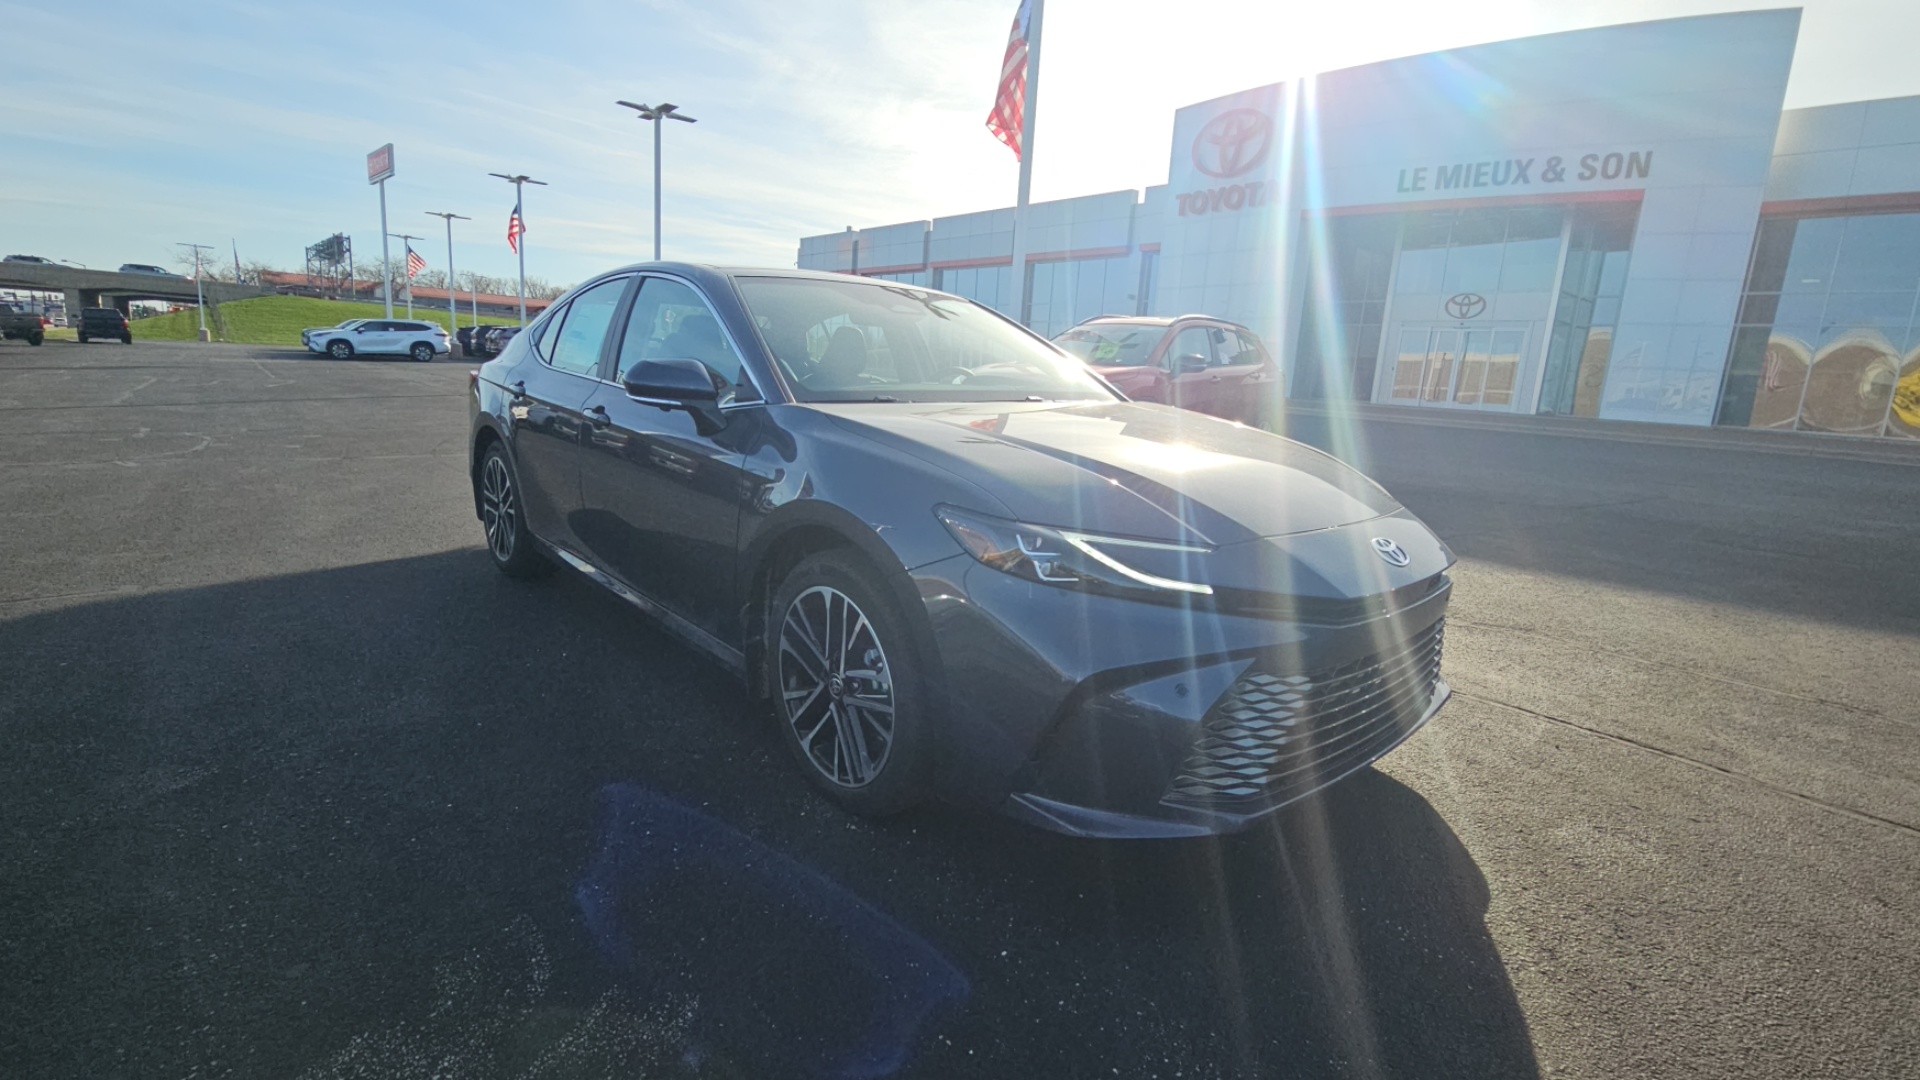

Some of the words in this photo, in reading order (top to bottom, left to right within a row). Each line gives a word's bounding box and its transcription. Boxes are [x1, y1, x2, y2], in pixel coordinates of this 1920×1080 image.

[1396, 166, 1429, 193] LE
[1434, 157, 1536, 190] MIEUX
[1540, 155, 1567, 183] &
[1577, 150, 1654, 182] SON
